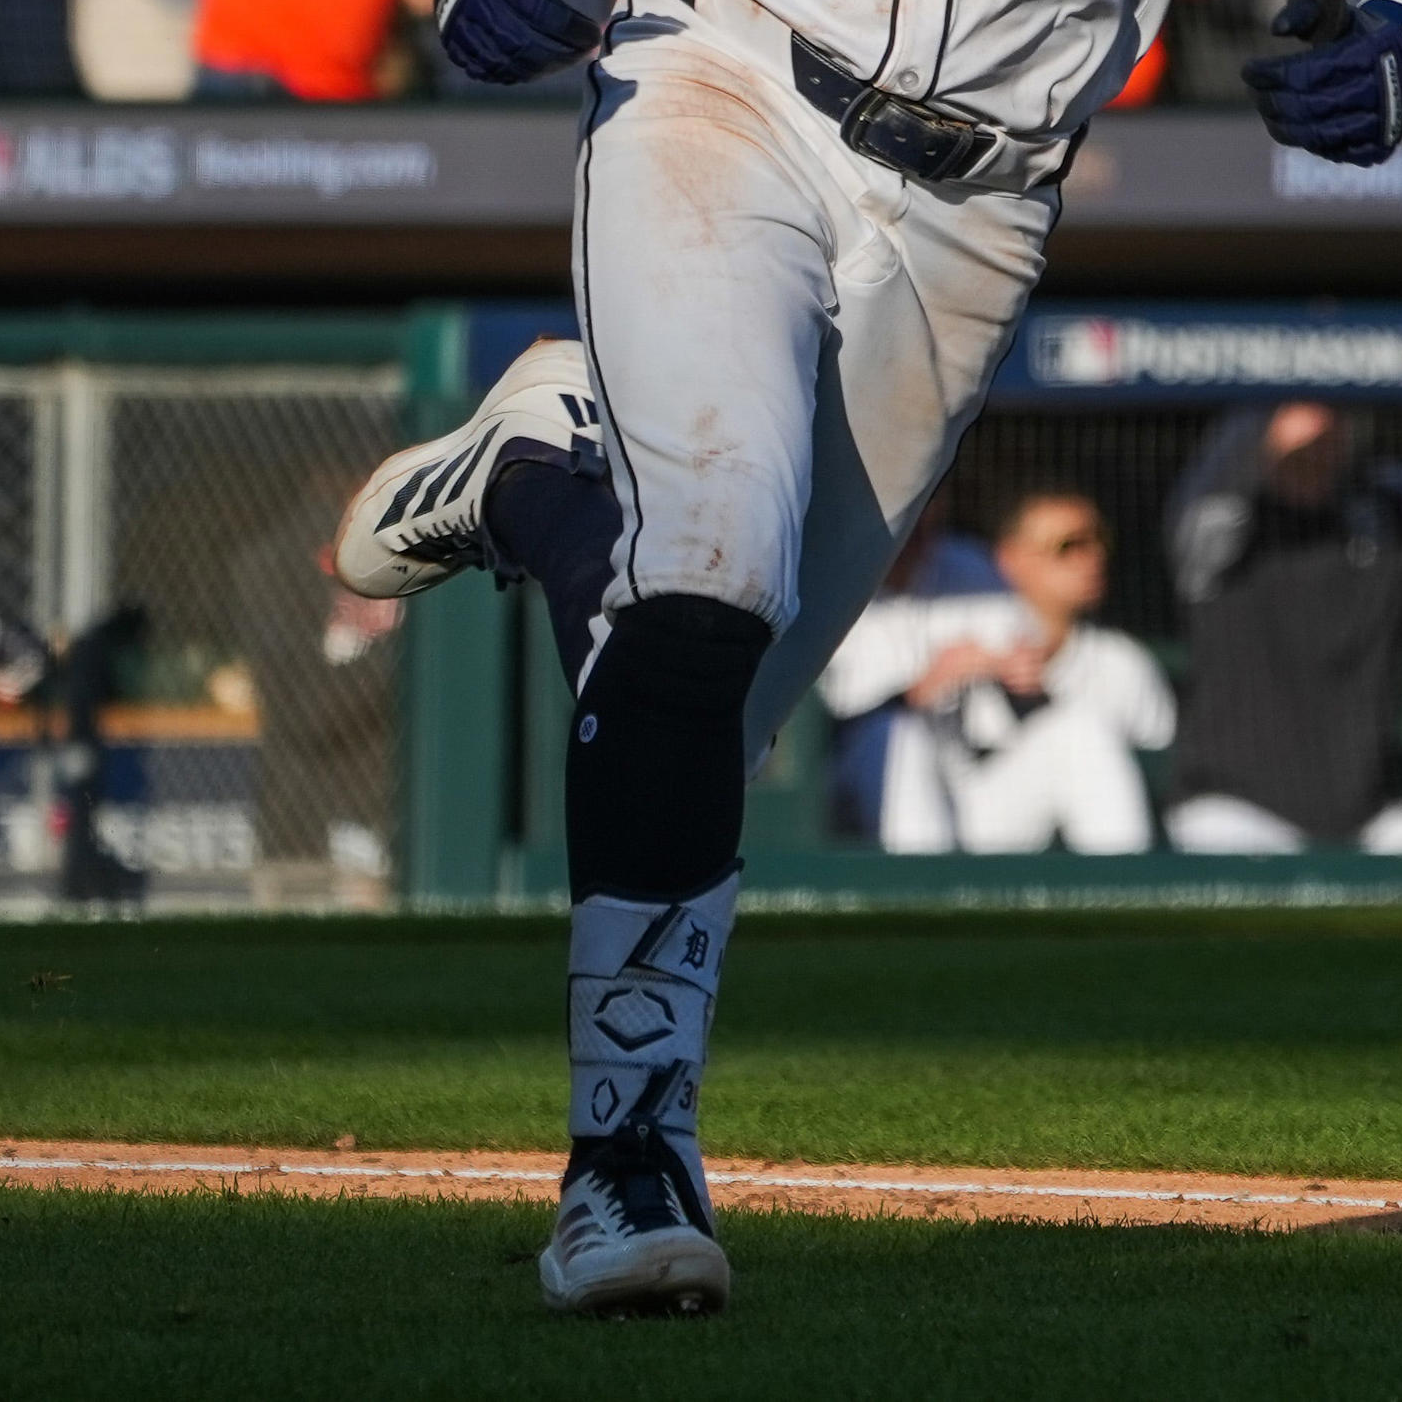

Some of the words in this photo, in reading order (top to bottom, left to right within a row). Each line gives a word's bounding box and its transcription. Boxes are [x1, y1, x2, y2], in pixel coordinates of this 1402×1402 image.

[24, 127, 179, 196] ALDS
[679, 920, 710, 971] D
[679, 1080, 697, 1110] 3
